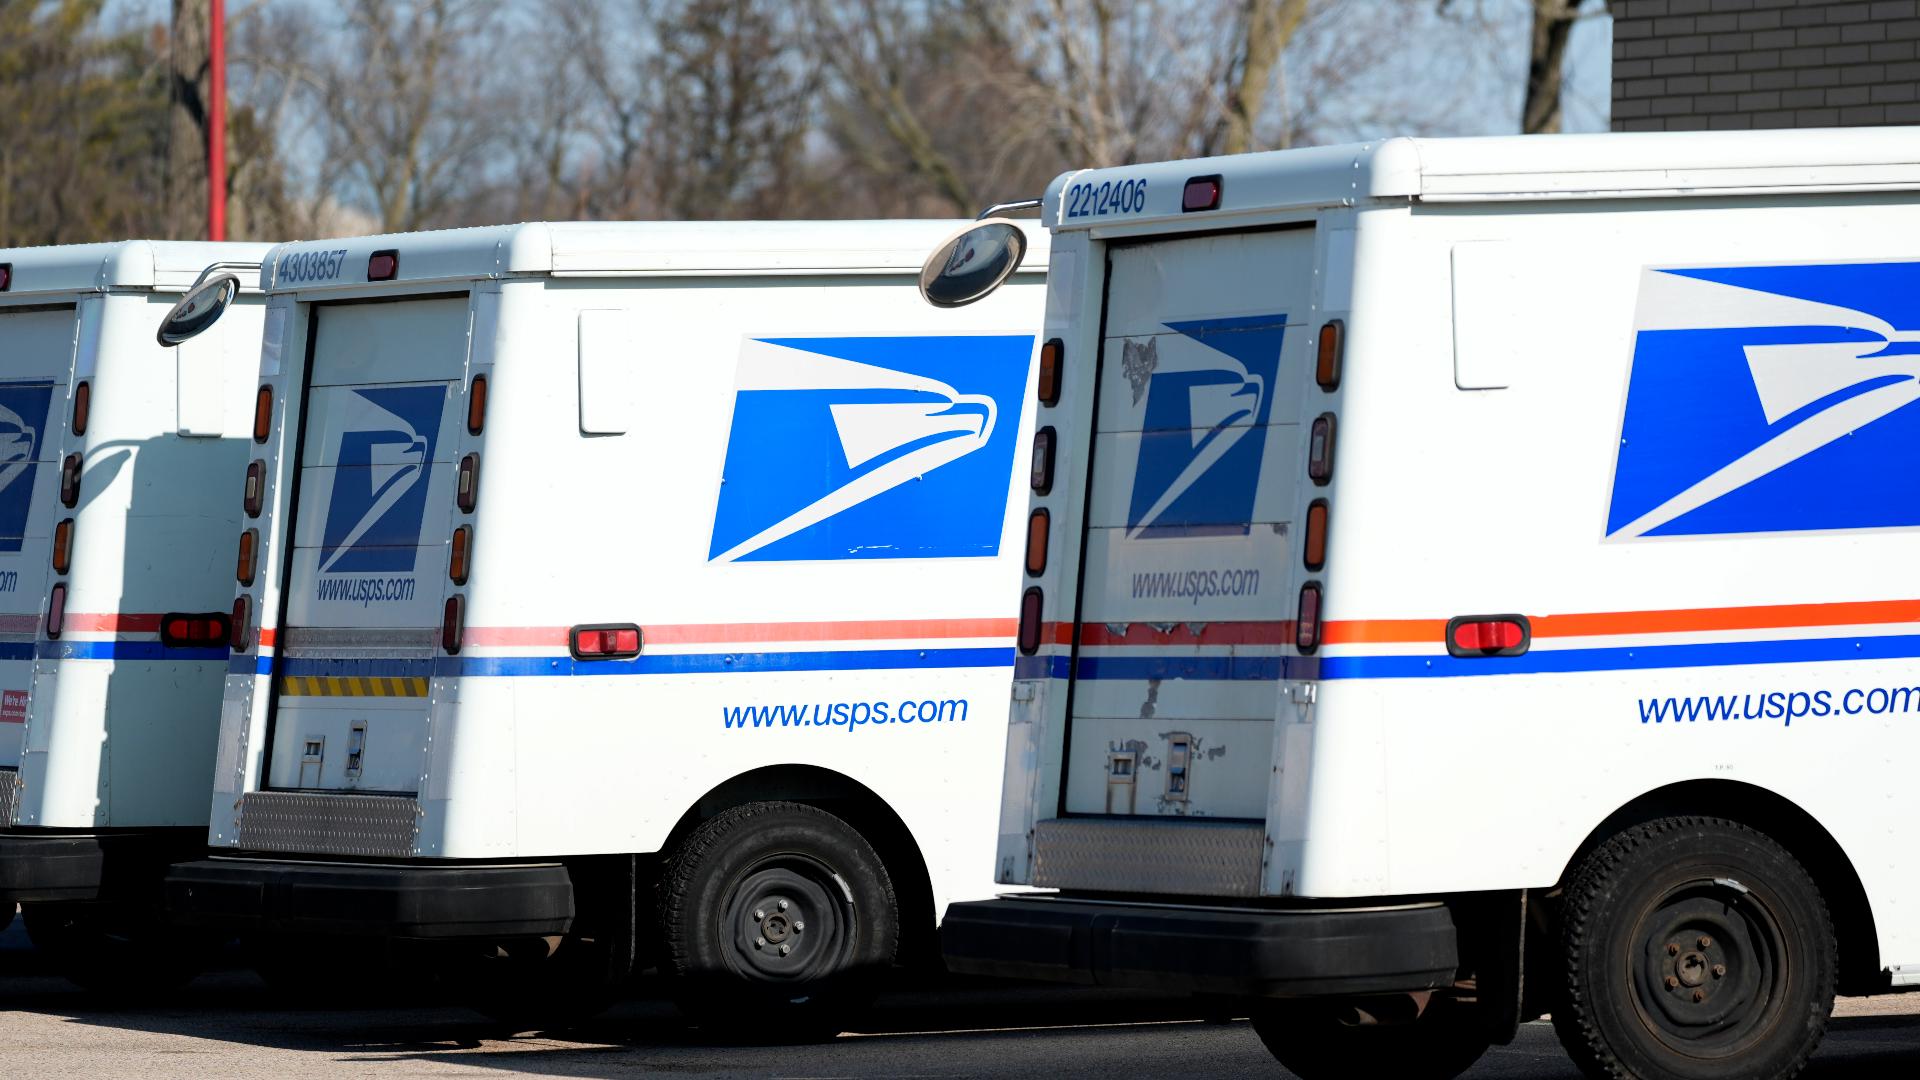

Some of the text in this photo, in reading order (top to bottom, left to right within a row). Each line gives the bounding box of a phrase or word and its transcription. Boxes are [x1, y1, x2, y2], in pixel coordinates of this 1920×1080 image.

[1068, 178, 1147, 217] 2212406
[279, 249, 347, 282] 4303857
[318, 578, 416, 608] www.usps.com
[1132, 568, 1260, 605] www.usps.com
[723, 699, 968, 732] www.usps.com
[1638, 686, 1920, 726] www.usps.com
